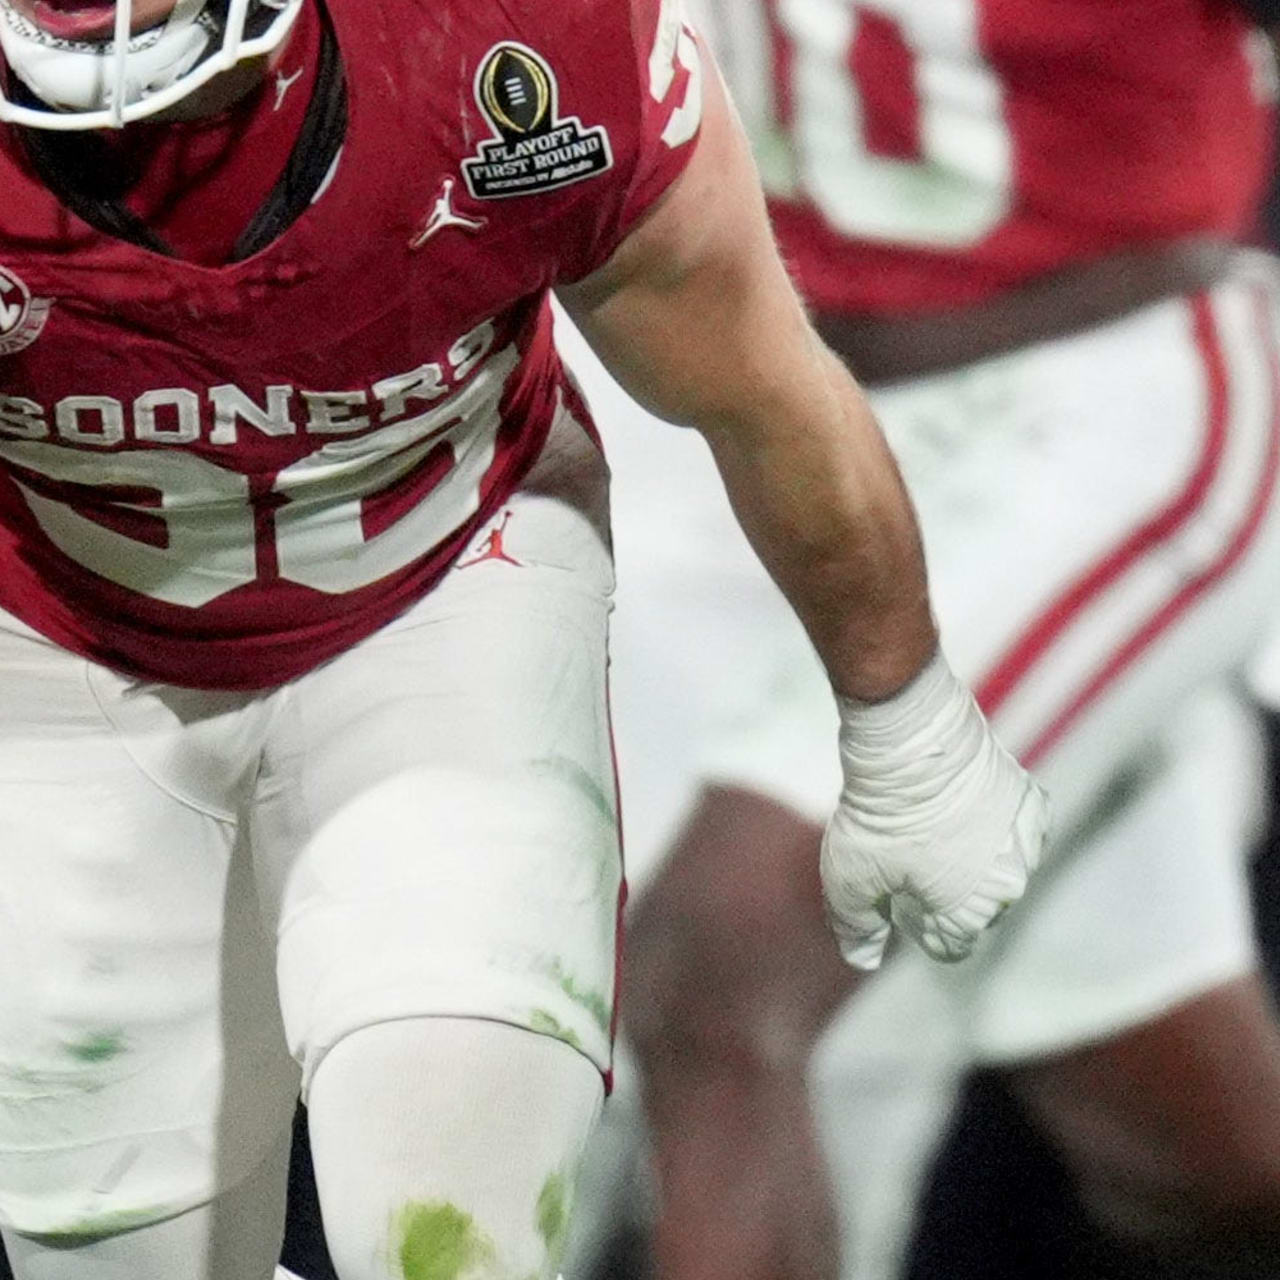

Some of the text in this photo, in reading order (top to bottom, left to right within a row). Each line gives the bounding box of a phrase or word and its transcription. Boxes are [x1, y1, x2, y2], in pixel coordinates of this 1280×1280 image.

[470, 137, 600, 180] FIRST ROUND
[488, 126, 575, 162] PLAYOFF
